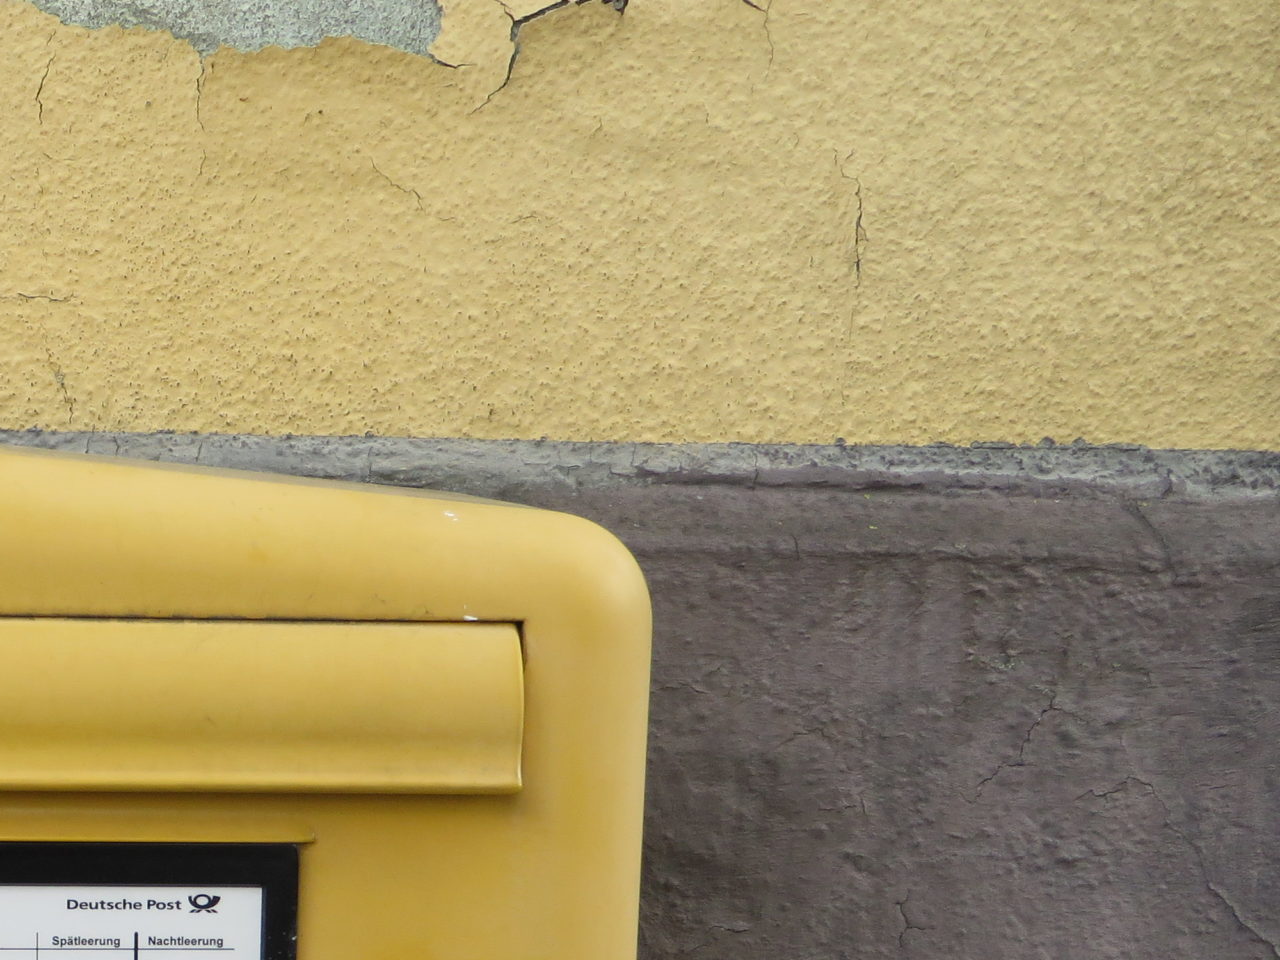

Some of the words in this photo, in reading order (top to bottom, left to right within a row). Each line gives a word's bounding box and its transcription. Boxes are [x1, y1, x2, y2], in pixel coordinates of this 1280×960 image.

[66, 899, 142, 910] Deutsche
[147, 899, 182, 910] Post
[52, 936, 120, 947] Spätleerung
[148, 936, 223, 948] Nachtleerung
